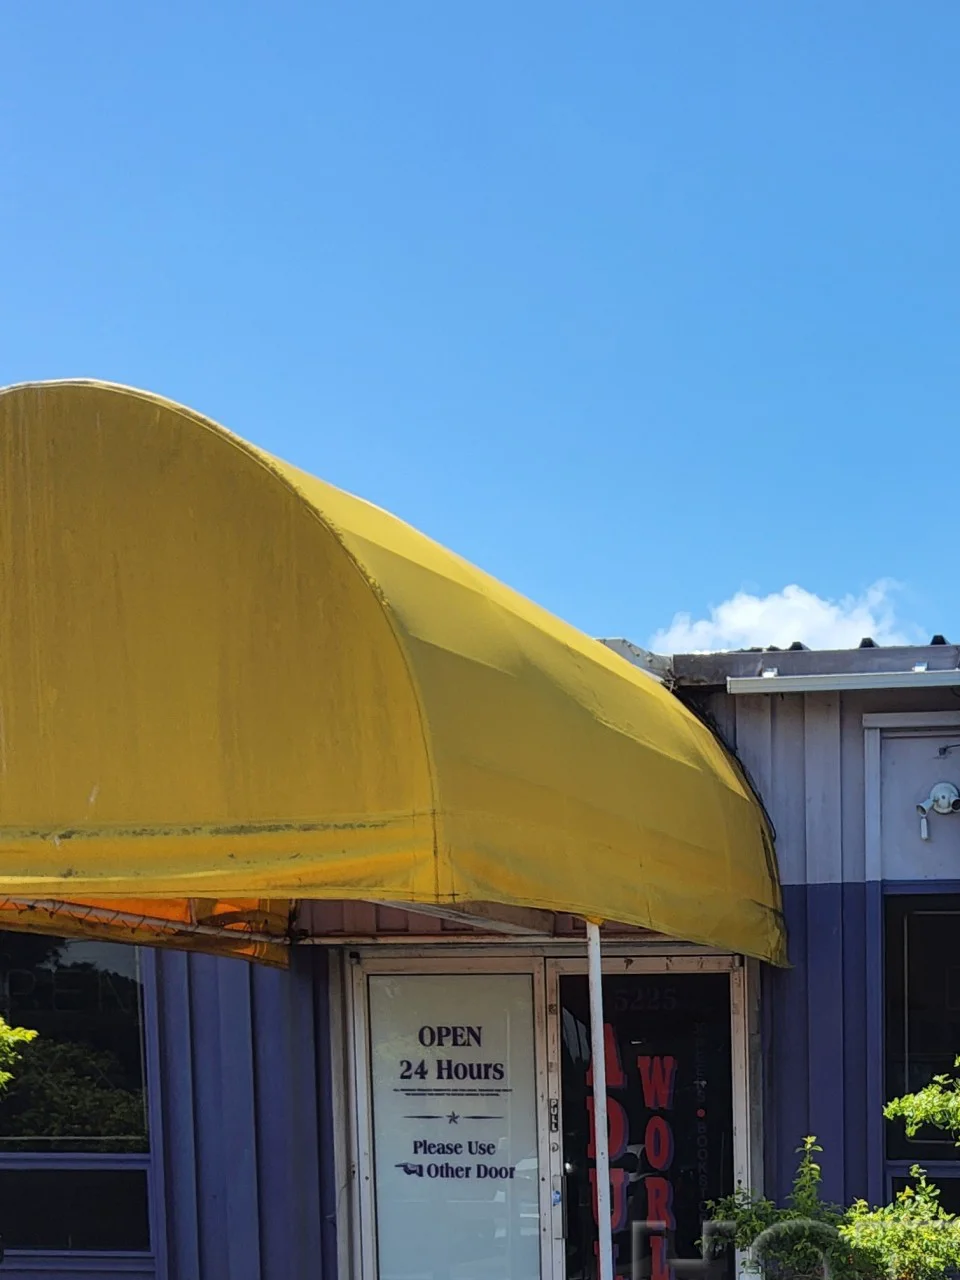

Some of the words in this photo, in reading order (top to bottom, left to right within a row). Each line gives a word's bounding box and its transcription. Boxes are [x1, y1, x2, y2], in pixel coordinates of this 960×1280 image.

[3, 968, 132, 1014] PEN
[418, 1025, 482, 1047] OPEN
[400, 1059, 429, 1080] 24
[436, 1059, 505, 1081] Hours
[550, 1099, 558, 1131] PULL
[413, 1140, 463, 1155] Please
[467, 1140, 496, 1155] Use
[426, 1162, 472, 1179] Other
[476, 1163, 516, 1179] Door
